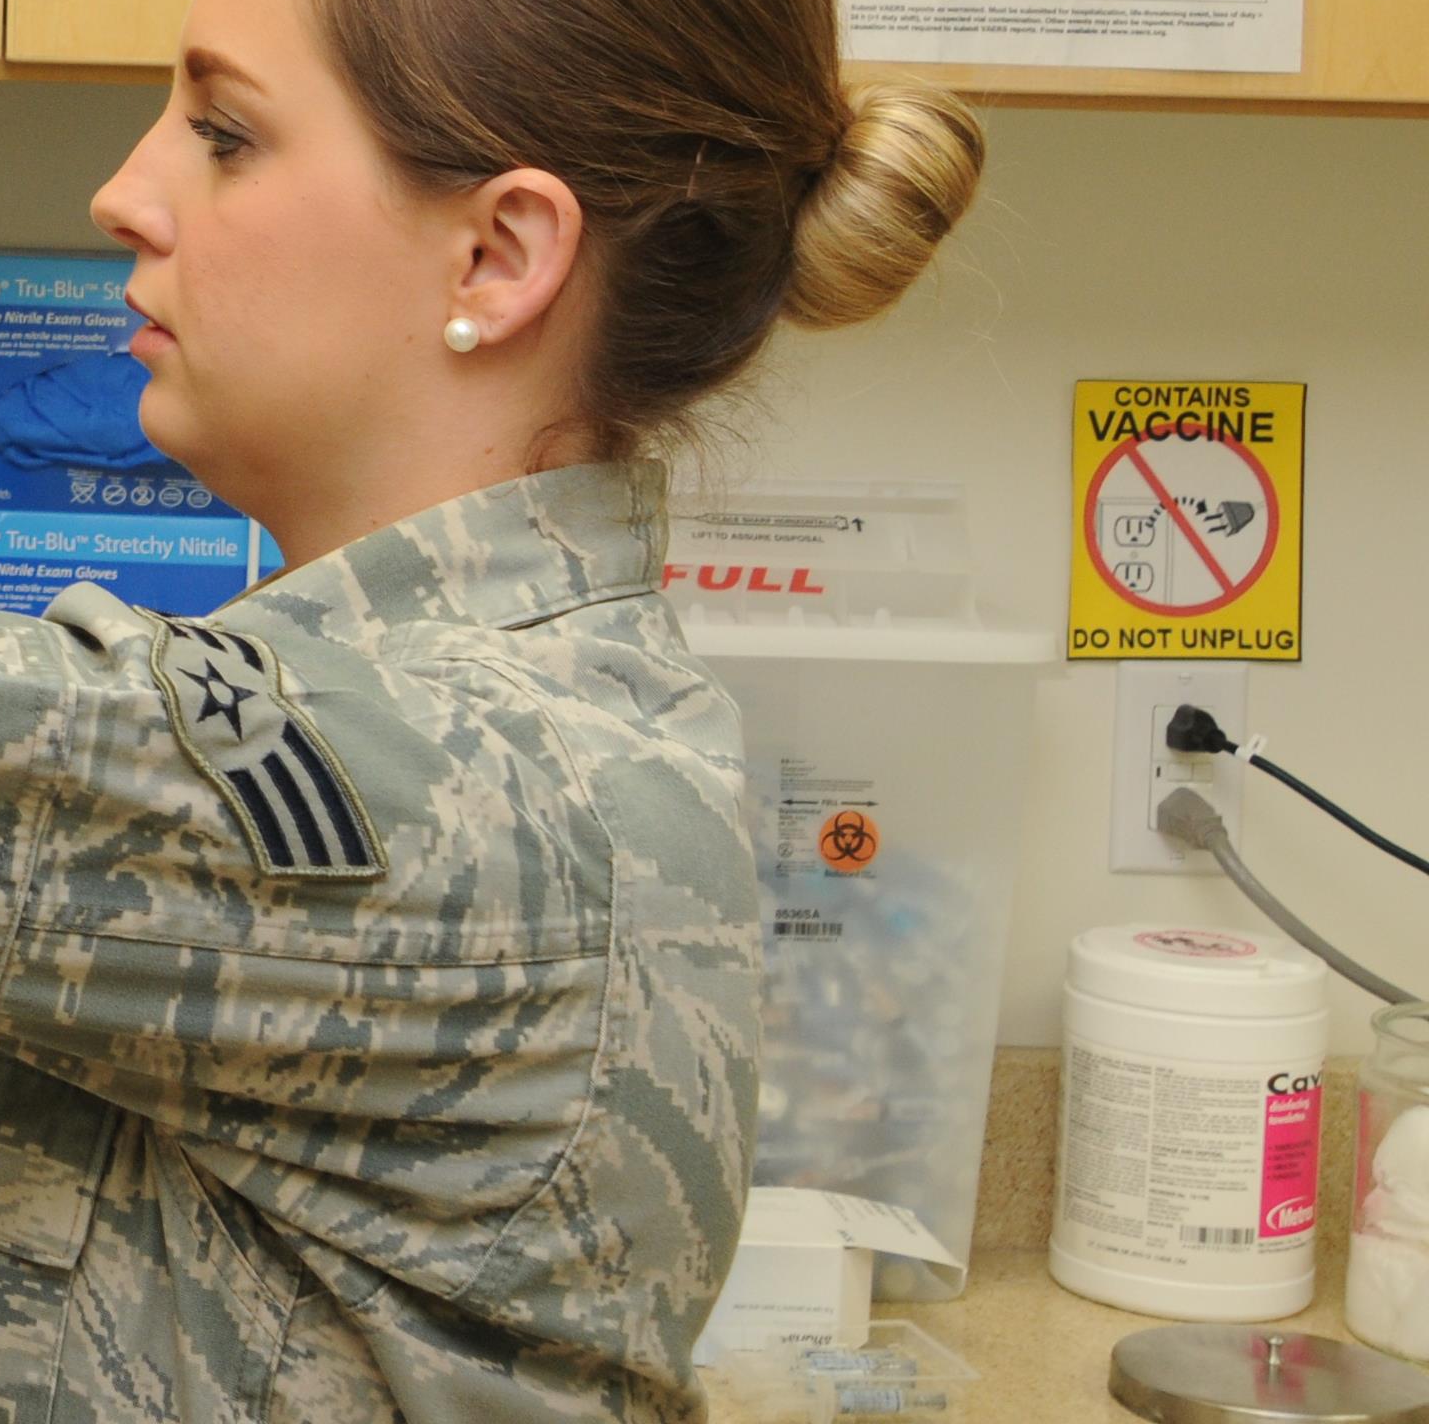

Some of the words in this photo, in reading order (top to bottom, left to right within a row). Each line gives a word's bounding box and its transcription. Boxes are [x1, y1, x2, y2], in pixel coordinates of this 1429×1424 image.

[4, 311, 43, 325] Nitrile
[45, 312, 82, 326] Exam
[84, 313, 127, 327] Gloves
[11, 332, 23, 340] en
[24, 331, 51, 341] nitrile
[52, 333, 72, 342] sans
[73, 332, 106, 343] poudre
[1115, 386, 1251, 408] CONTAINS
[1089, 411, 1275, 443] VACCINE
[94, 533, 174, 560] Stretchy
[178, 536, 238, 558] Nitrile
[692, 532, 713, 540] LIFT
[715, 532, 728, 540] TO
[730, 532, 771, 542] ASSURE
[774, 534, 825, 543] DISPOSAL
[37, 564, 73, 578] Exam
[75, 566, 118, 581] Gloves
[662, 563, 825, 594] FULL
[1073, 628, 1109, 650] DO
[1118, 628, 1173, 650] NOT
[1181, 628, 1295, 651] UNPLUG
